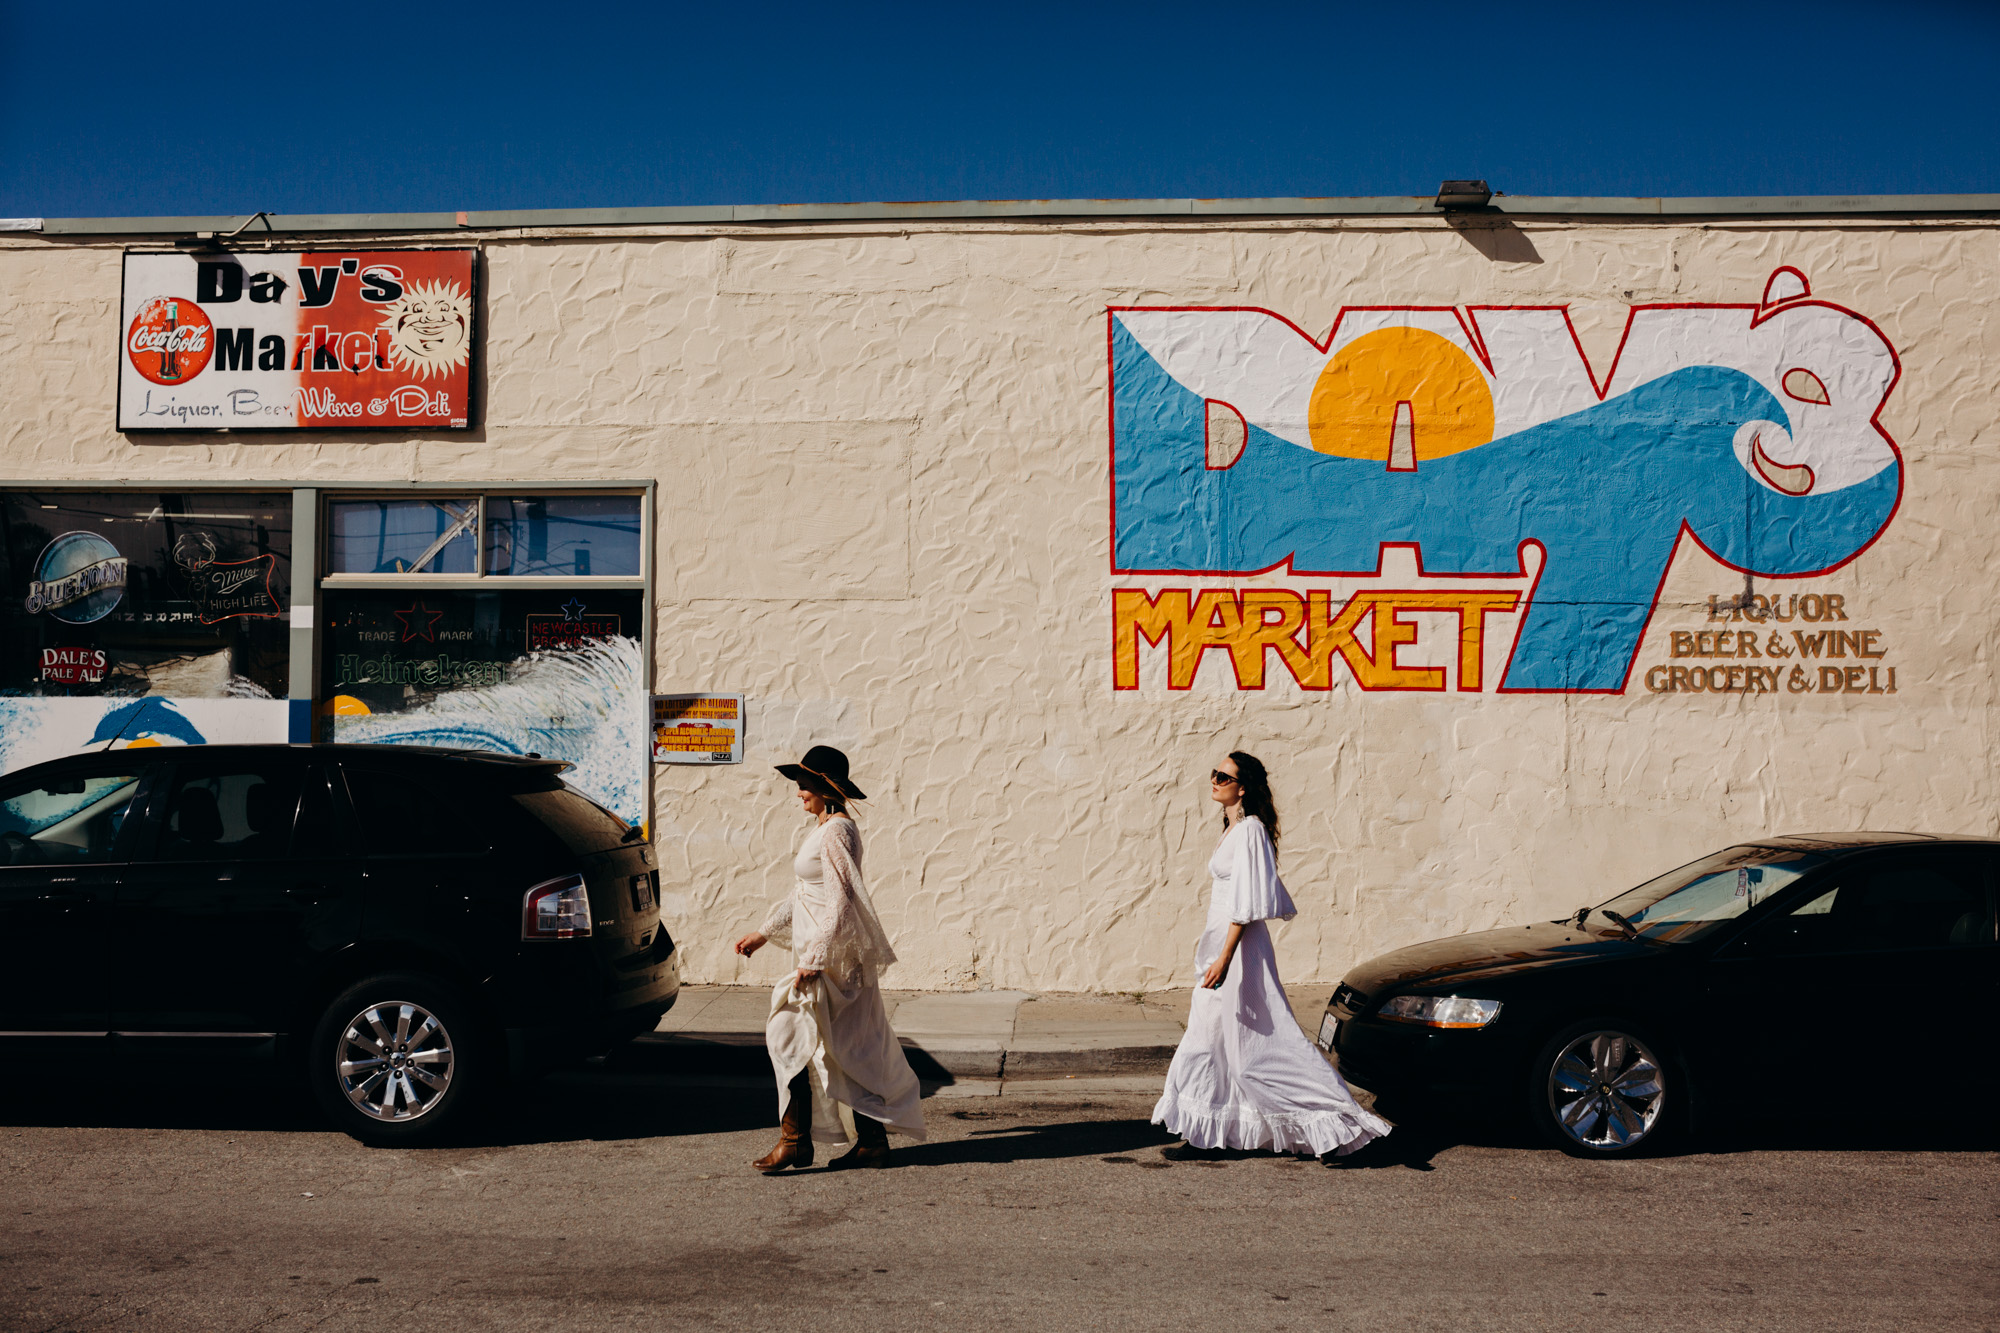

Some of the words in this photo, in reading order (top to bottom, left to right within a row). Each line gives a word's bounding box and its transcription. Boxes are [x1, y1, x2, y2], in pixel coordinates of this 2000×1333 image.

[196, 258, 404, 308] Day's
[129, 325, 211, 353] Coca-Cola
[214, 325, 395, 373] Market
[138, 389, 223, 424] Liquor,
[293, 386, 363, 418] Wine
[366, 398, 389, 415] &
[389, 384, 451, 417] Deli
[1107, 265, 1906, 695] DAY'S
[73, 561, 127, 596] MOON
[211, 567, 260, 590] Miller
[210, 598, 240, 611] HIGH
[242, 593, 270, 608] LIFE
[1707, 594, 1849, 624] LIQUOR
[358, 631, 396, 642] TRADE
[439, 630, 474, 642] MARK
[532, 622, 614, 635] NEWCASTLE
[1112, 588, 1520, 693] MARKET
[42, 648, 106, 668] DALE'S
[1669, 630, 1762, 660] BEER
[1765, 629, 1795, 659] &
[1790, 629, 1888, 660] WINE
[42, 667, 74, 680] PALE
[79, 668, 105, 682] ALE
[335, 653, 507, 687] Heineken
[1644, 664, 1785, 694] GROCERY
[1786, 663, 1816, 694] &
[1816, 664, 1898, 695] DELI
[708, 699, 738, 709] ALLOWED
[689, 744, 731, 752] PREMISES
